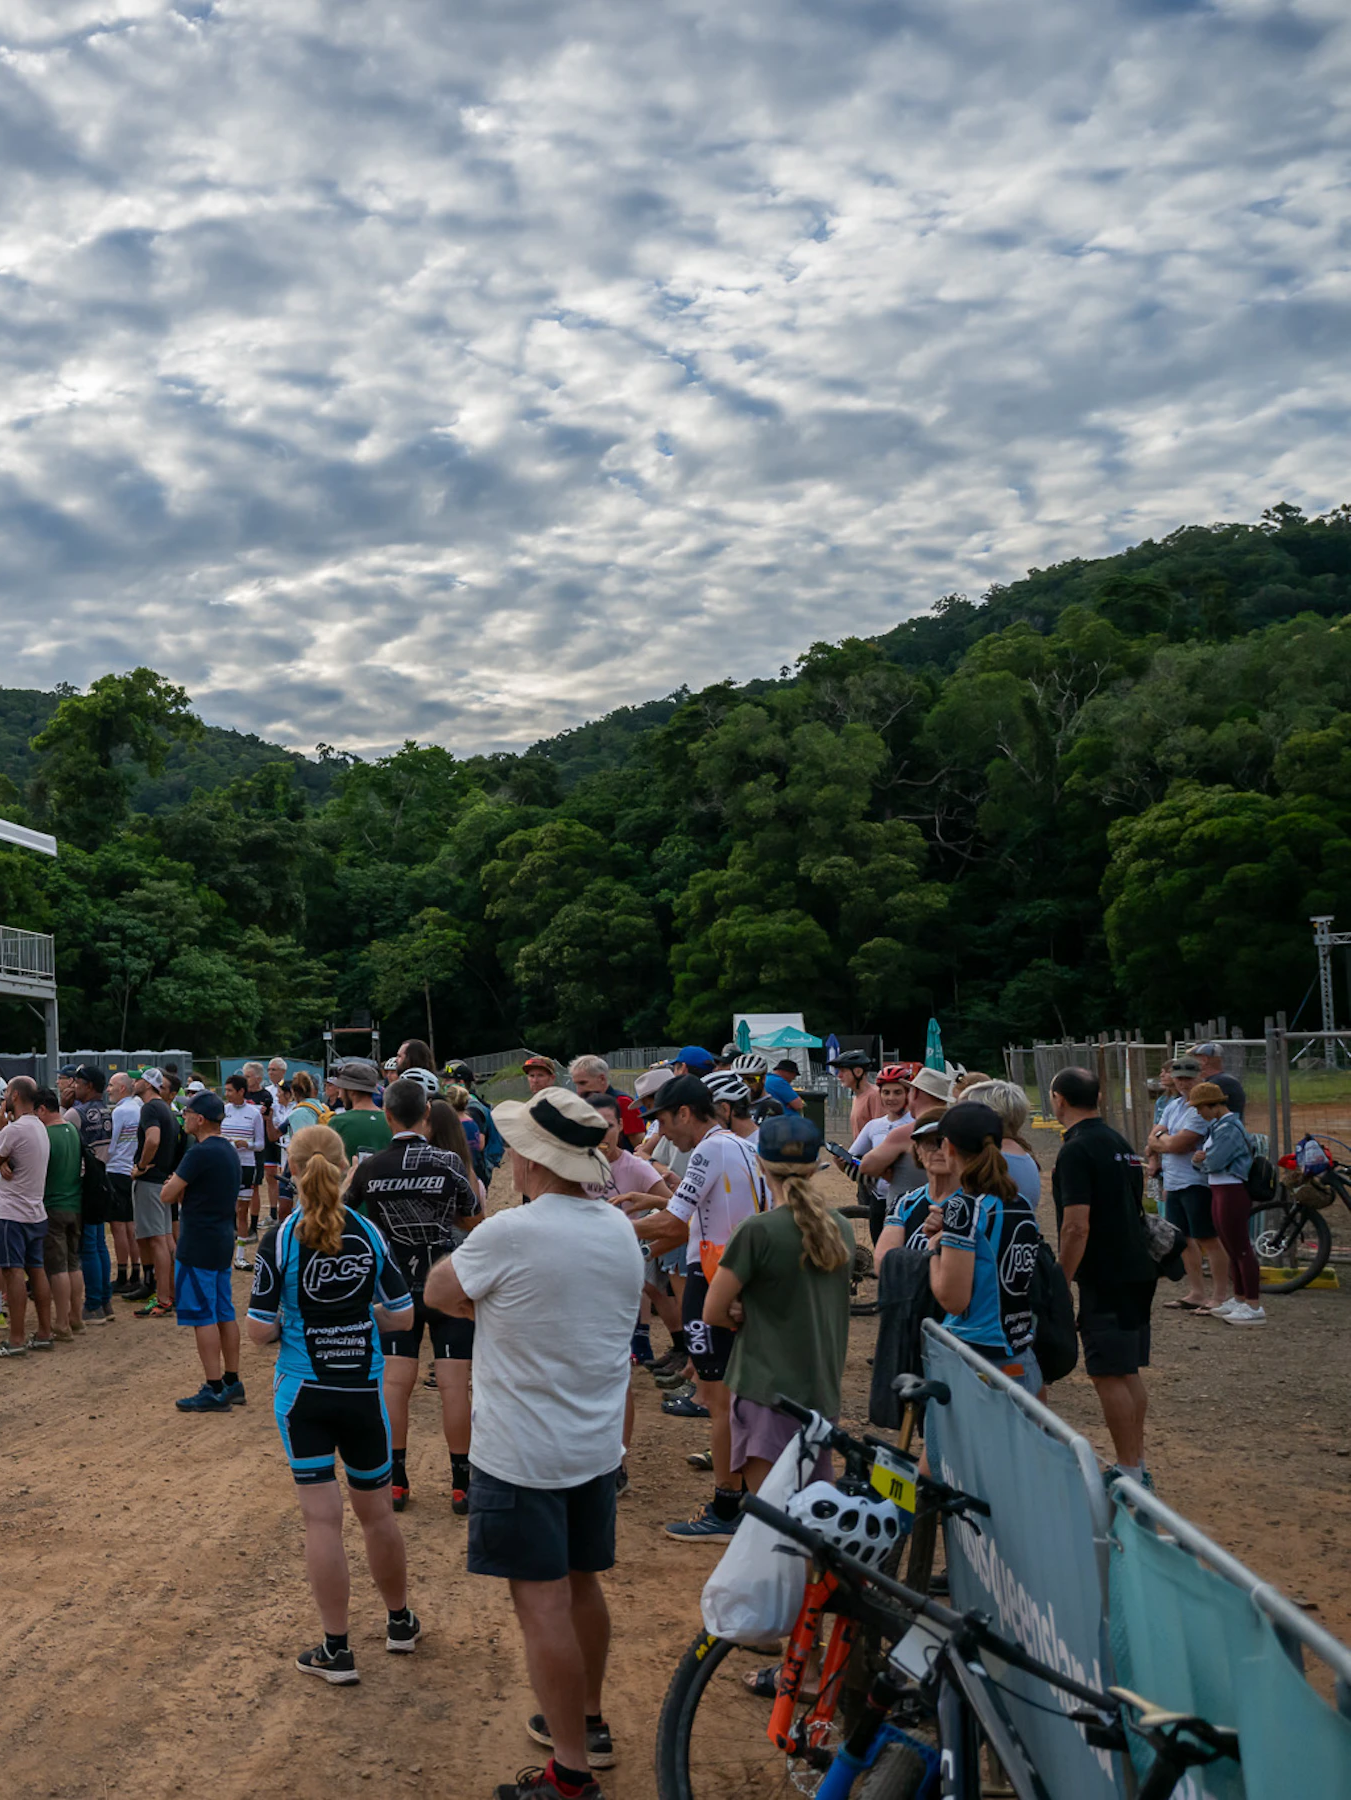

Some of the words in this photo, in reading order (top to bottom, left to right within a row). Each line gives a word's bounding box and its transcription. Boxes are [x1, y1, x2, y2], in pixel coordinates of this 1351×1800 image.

[366, 1175, 446, 1194] SPECIALIZED
[308, 1253, 374, 1292] pcs
[305, 1320, 373, 1336] progressive
[314, 1335, 367, 1348] coaching
[315, 1348, 367, 1361] systems
